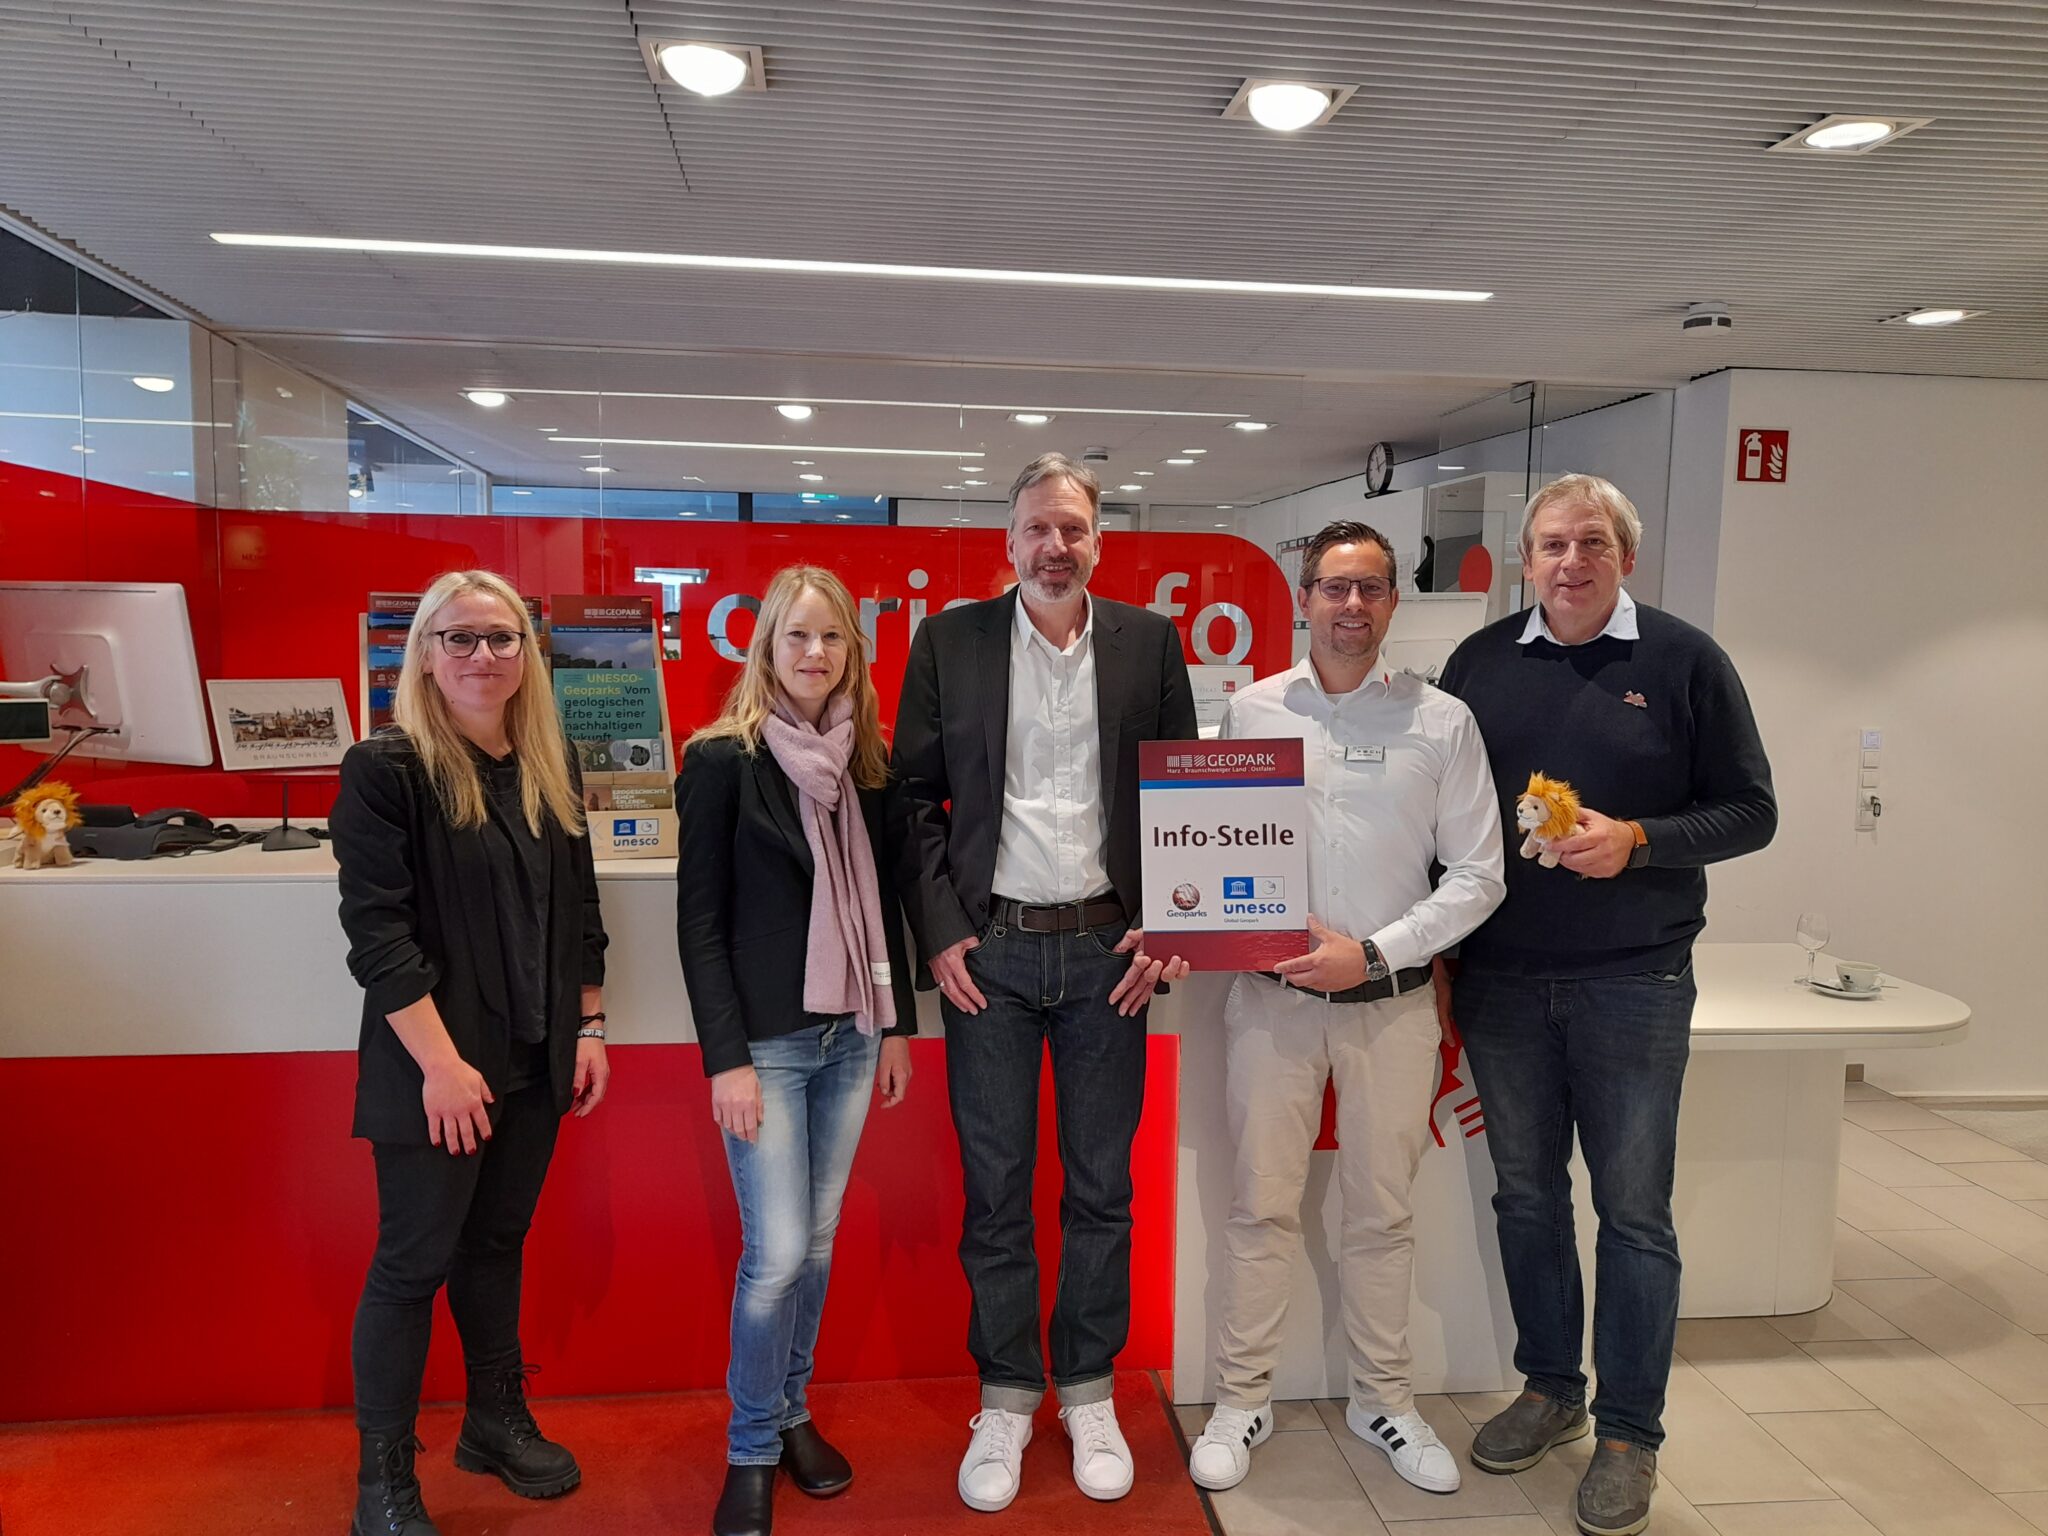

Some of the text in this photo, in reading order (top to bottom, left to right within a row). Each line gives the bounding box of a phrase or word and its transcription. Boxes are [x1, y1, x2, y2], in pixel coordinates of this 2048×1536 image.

[605, 608, 641, 616] GEOPARK
[587, 673, 643, 683] UNESCO-
[564, 686, 651, 696] Geoparks Vom
[564, 697, 644, 708] geologischen
[565, 709, 593, 718] Erbe
[616, 709, 646, 718] einer
[565, 721, 642, 732] nachhaltigen
[1207, 753, 1276, 767] GEOPARK
[1154, 823, 1294, 847] Info-Stelle
[613, 838, 659, 847] unesco
[1223, 903, 1286, 914] unesco
[1166, 909, 1208, 919] Geoparks
